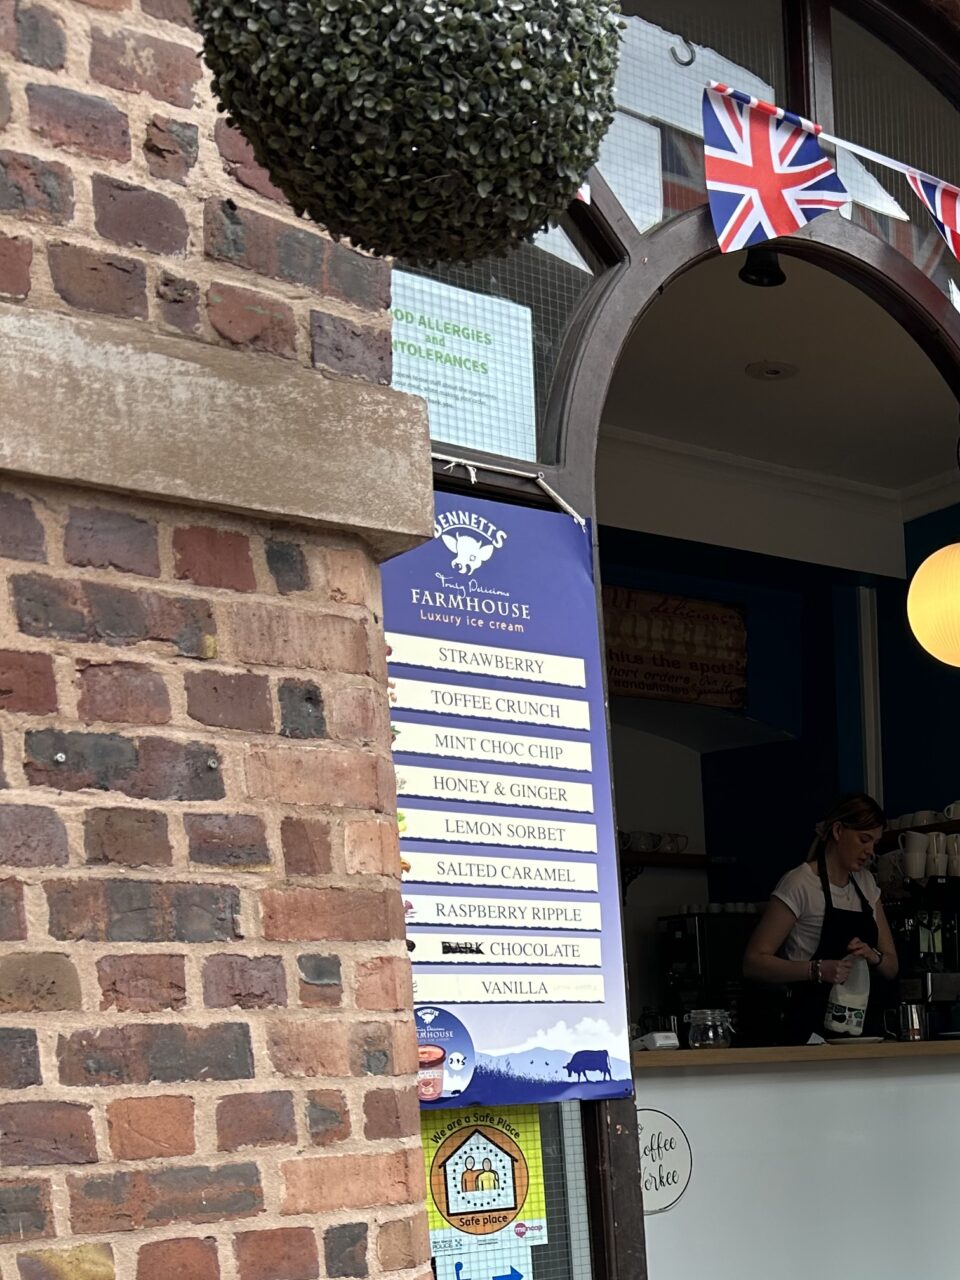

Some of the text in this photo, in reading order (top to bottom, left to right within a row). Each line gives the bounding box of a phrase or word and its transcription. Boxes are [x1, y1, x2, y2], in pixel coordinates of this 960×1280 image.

[418, 316, 492, 346] ALLERGIES
[424, 334, 446, 347] and
[411, 588, 531, 620] FARMHOUSE
[420, 609, 525, 633] Luxury ice cream
[439, 647, 544, 674] STRAWBERRY
[431, 689, 561, 718] TOFFEE CRUNCH
[435, 733, 564, 761] MINT CHOC CHIP
[433, 776, 568, 802] HONEY & GINGER
[445, 818, 566, 842] LEMON SORBET
[436, 860, 576, 883] SALTED CARAMEL
[436, 902, 582, 922] RASPBERRY RIPPLE
[489, 942, 581, 958] CHOCOLATE
[482, 981, 549, 995] VANILLA
[430, 1112, 521, 1145] We are a Safe Place
[641, 1131, 677, 1163] offee
[641, 1164, 679, 1192] orkee
[459, 1214, 508, 1227] Safe place
